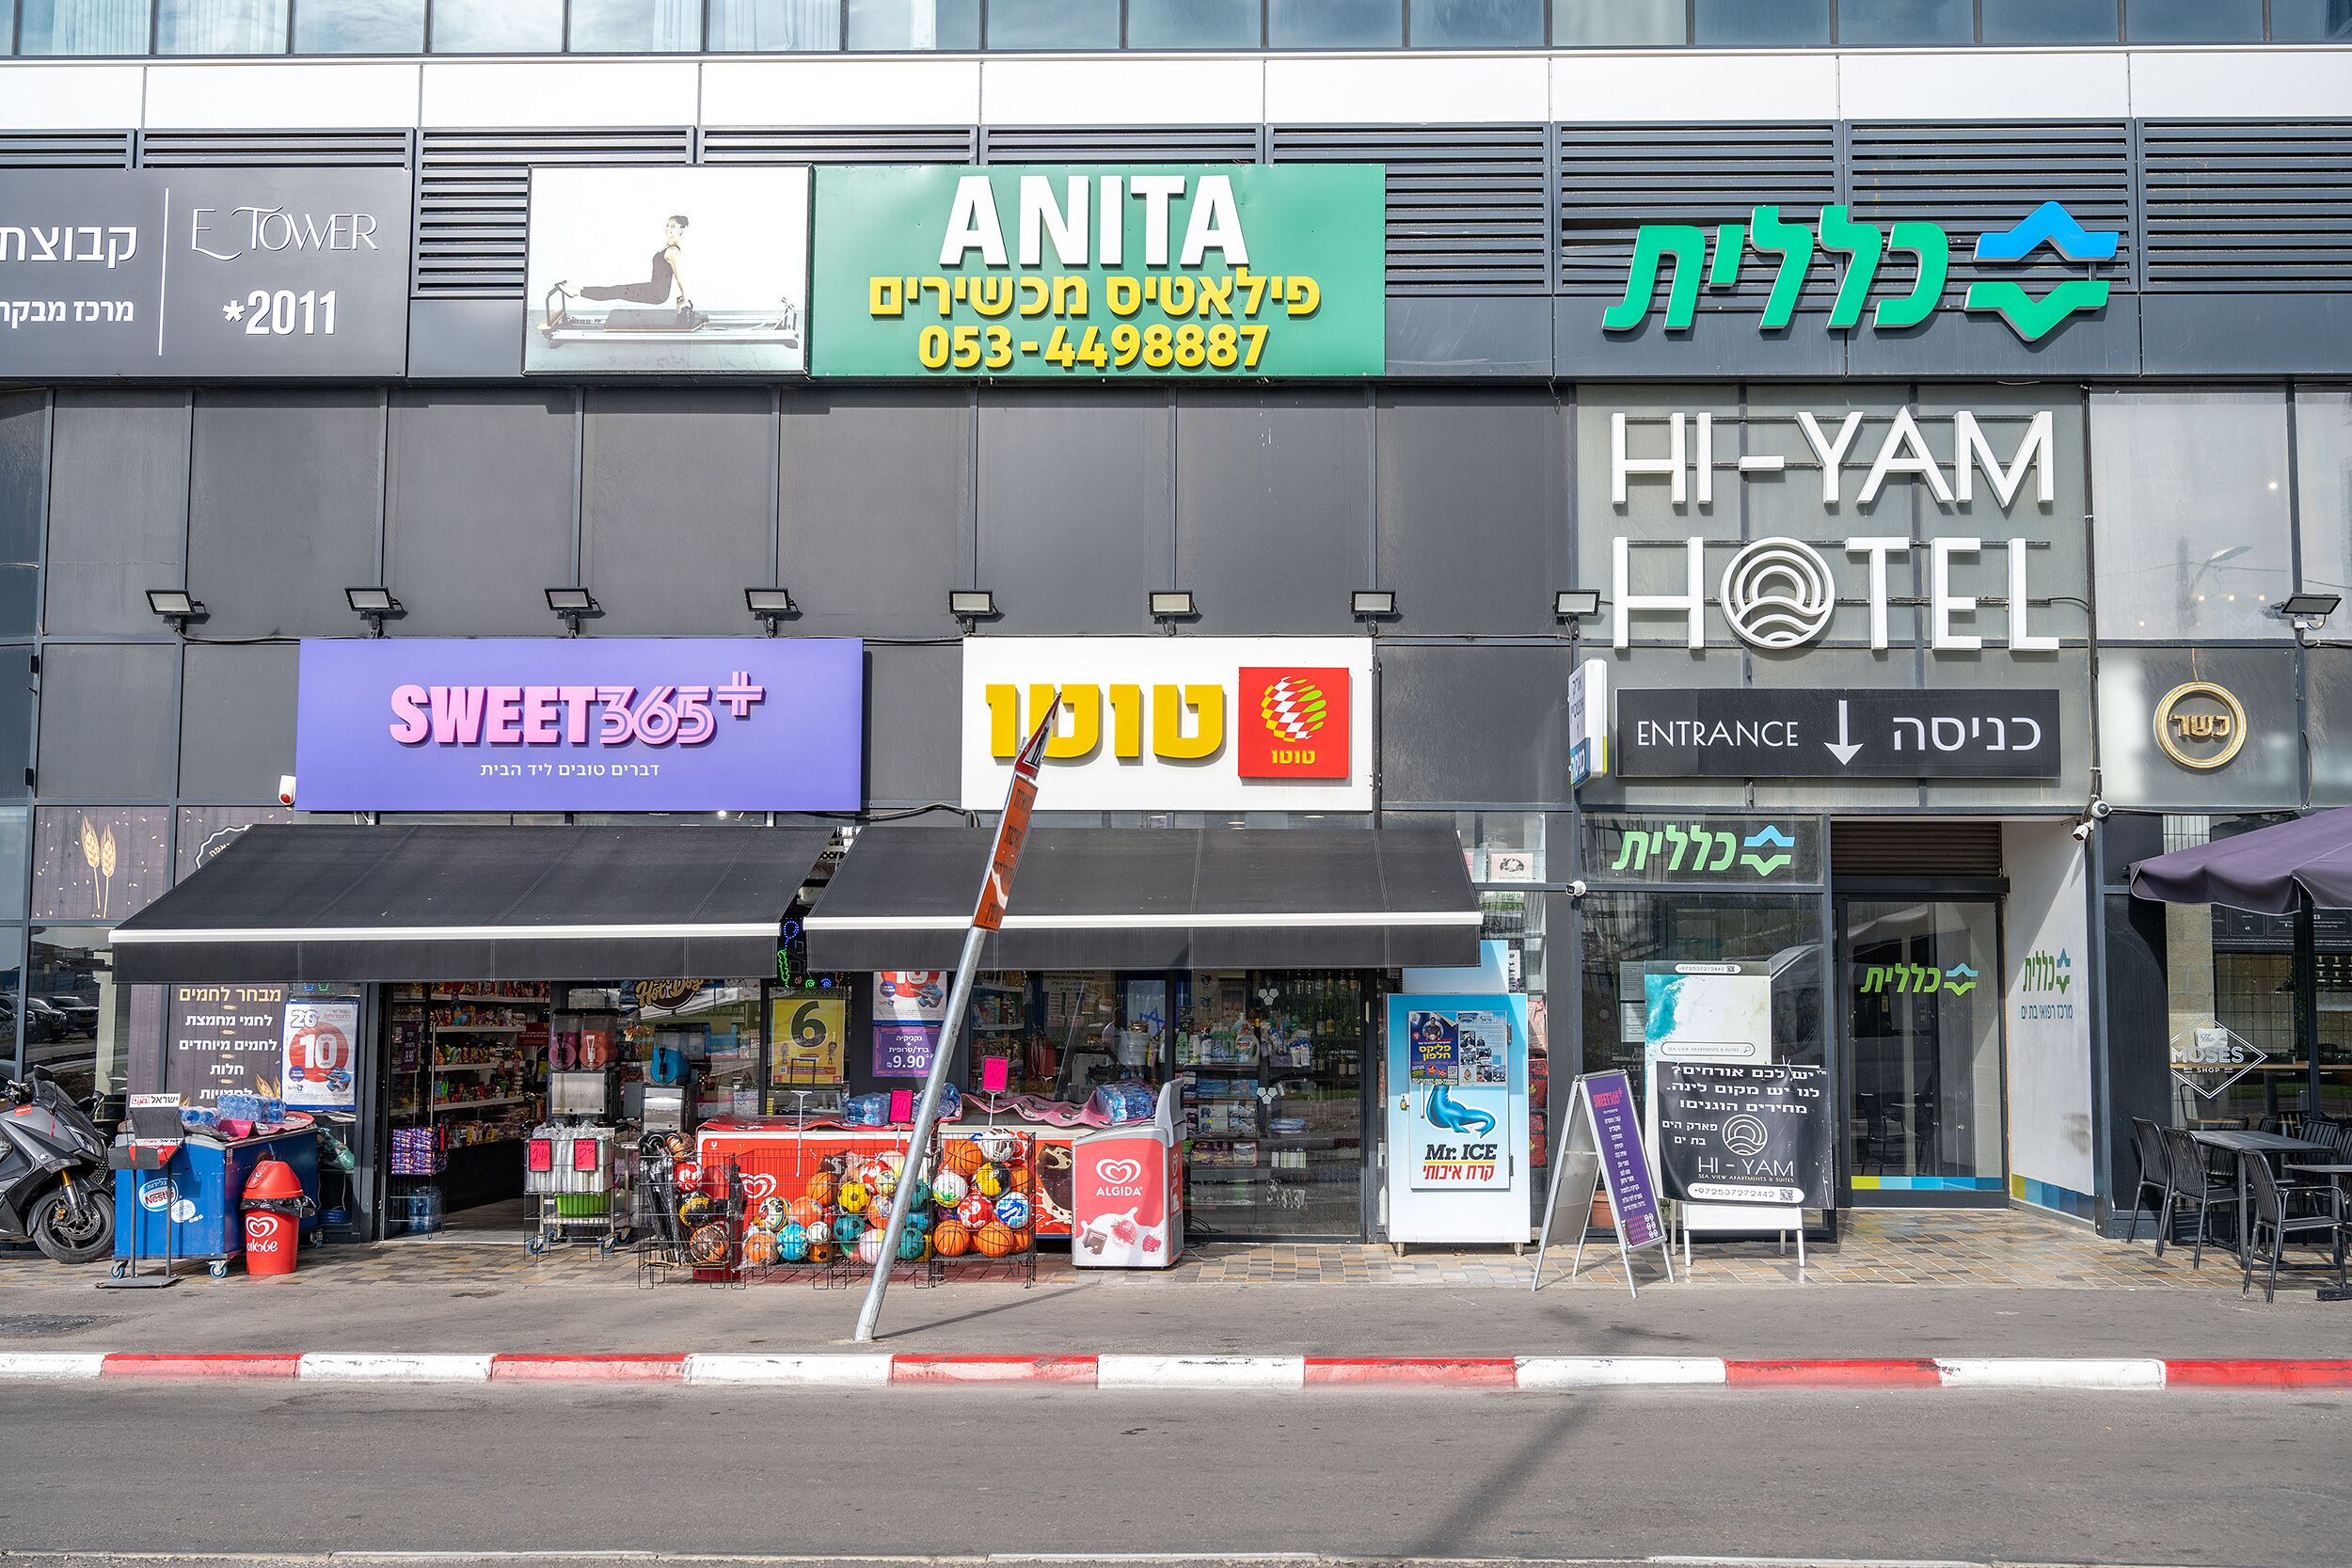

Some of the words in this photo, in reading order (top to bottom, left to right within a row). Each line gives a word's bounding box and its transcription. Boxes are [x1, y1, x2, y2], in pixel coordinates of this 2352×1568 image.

[938, 175, 1251, 266] ANITA
[191, 208, 242, 261] E
[231, 206, 378, 252] TOWER
[1601, 205, 1948, 331] כללית
[869, 274, 1089, 317] מכשירים
[1106, 267, 1322, 317] פילאטיס
[73, 300, 135, 322] מרכז
[918, 325, 1269, 369] 053-4498887
[1611, 404, 2054, 508] HI-YAM
[1613, 536, 2060, 653] HOTEL
[986, 684, 1224, 758] טוטו
[2169, 714, 2232, 740] כשר
[1636, 721, 1799, 748] ENTRANCE
[1892, 716, 2043, 752] כניסה
[1271, 749, 1316, 765] טוטו
[480, 763, 522, 777] הבית
[527, 761, 553, 777] ליד
[558, 763, 606, 777] טובים
[612, 763, 660, 777] דברים
[1612, 824, 1737, 871] כללית
[1860, 962, 1941, 993] כללית
[2023, 950, 2055, 992] כללית
[179, 987, 230, 1003] לחמים
[235, 989, 281, 1003] מבחר
[636, 981, 666, 1006] Hot
[2021, 1005, 2028, 1020] ים
[2028, 1005, 2039, 1020] בת
[2039, 1004, 2056, 1020] רפואי
[2057, 1004, 2074, 1020] מרכז
[185, 1015, 236, 1026] מחמצת
[239, 1014, 274, 1027] לחמי
[791, 999, 828, 1049] 6
[179, 1039, 230, 1051] מיוחדים
[234, 1038, 278, 1052] לחמים
[299, 1033, 338, 1069] 10
[1419, 1044, 1452, 1054] פליקס
[893, 1054, 925, 1069] 9.90
[1422, 1052, 1452, 1061] חלפון
[2171, 1045, 2245, 1064] MOSES
[210, 1063, 245, 1075] חלות
[1671, 1066, 1744, 1078] אורחים?
[1752, 1067, 1785, 1079] לכם
[1791, 1070, 1814, 1080] יש
[1666, 1082, 1708, 1093] לינה.
[1715, 1085, 1759, 1096] מקום
[1767, 1085, 1790, 1096] יש
[1797, 1087, 1820, 1098] לנו
[151, 1095, 179, 1104] ישראל
[1679, 1100, 1739, 1112] הוגנים!
[1745, 1102, 1807, 1115] מחירים
[1661, 1120, 1682, 1129] הים
[1687, 1122, 1718, 1132] פארק
[1674, 1135, 1687, 1144] ים
[1691, 1136, 1707, 1145] בת
[1425, 1144, 1457, 1161] Mr.
[1461, 1144, 1498, 1160] ICE
[1423, 1164, 1462, 1180] איכותי
[1466, 1164, 1496, 1181] קרח
[1741, 1158, 1794, 1177] YAM
[1095, 1185, 1143, 1196] ALGIDA
